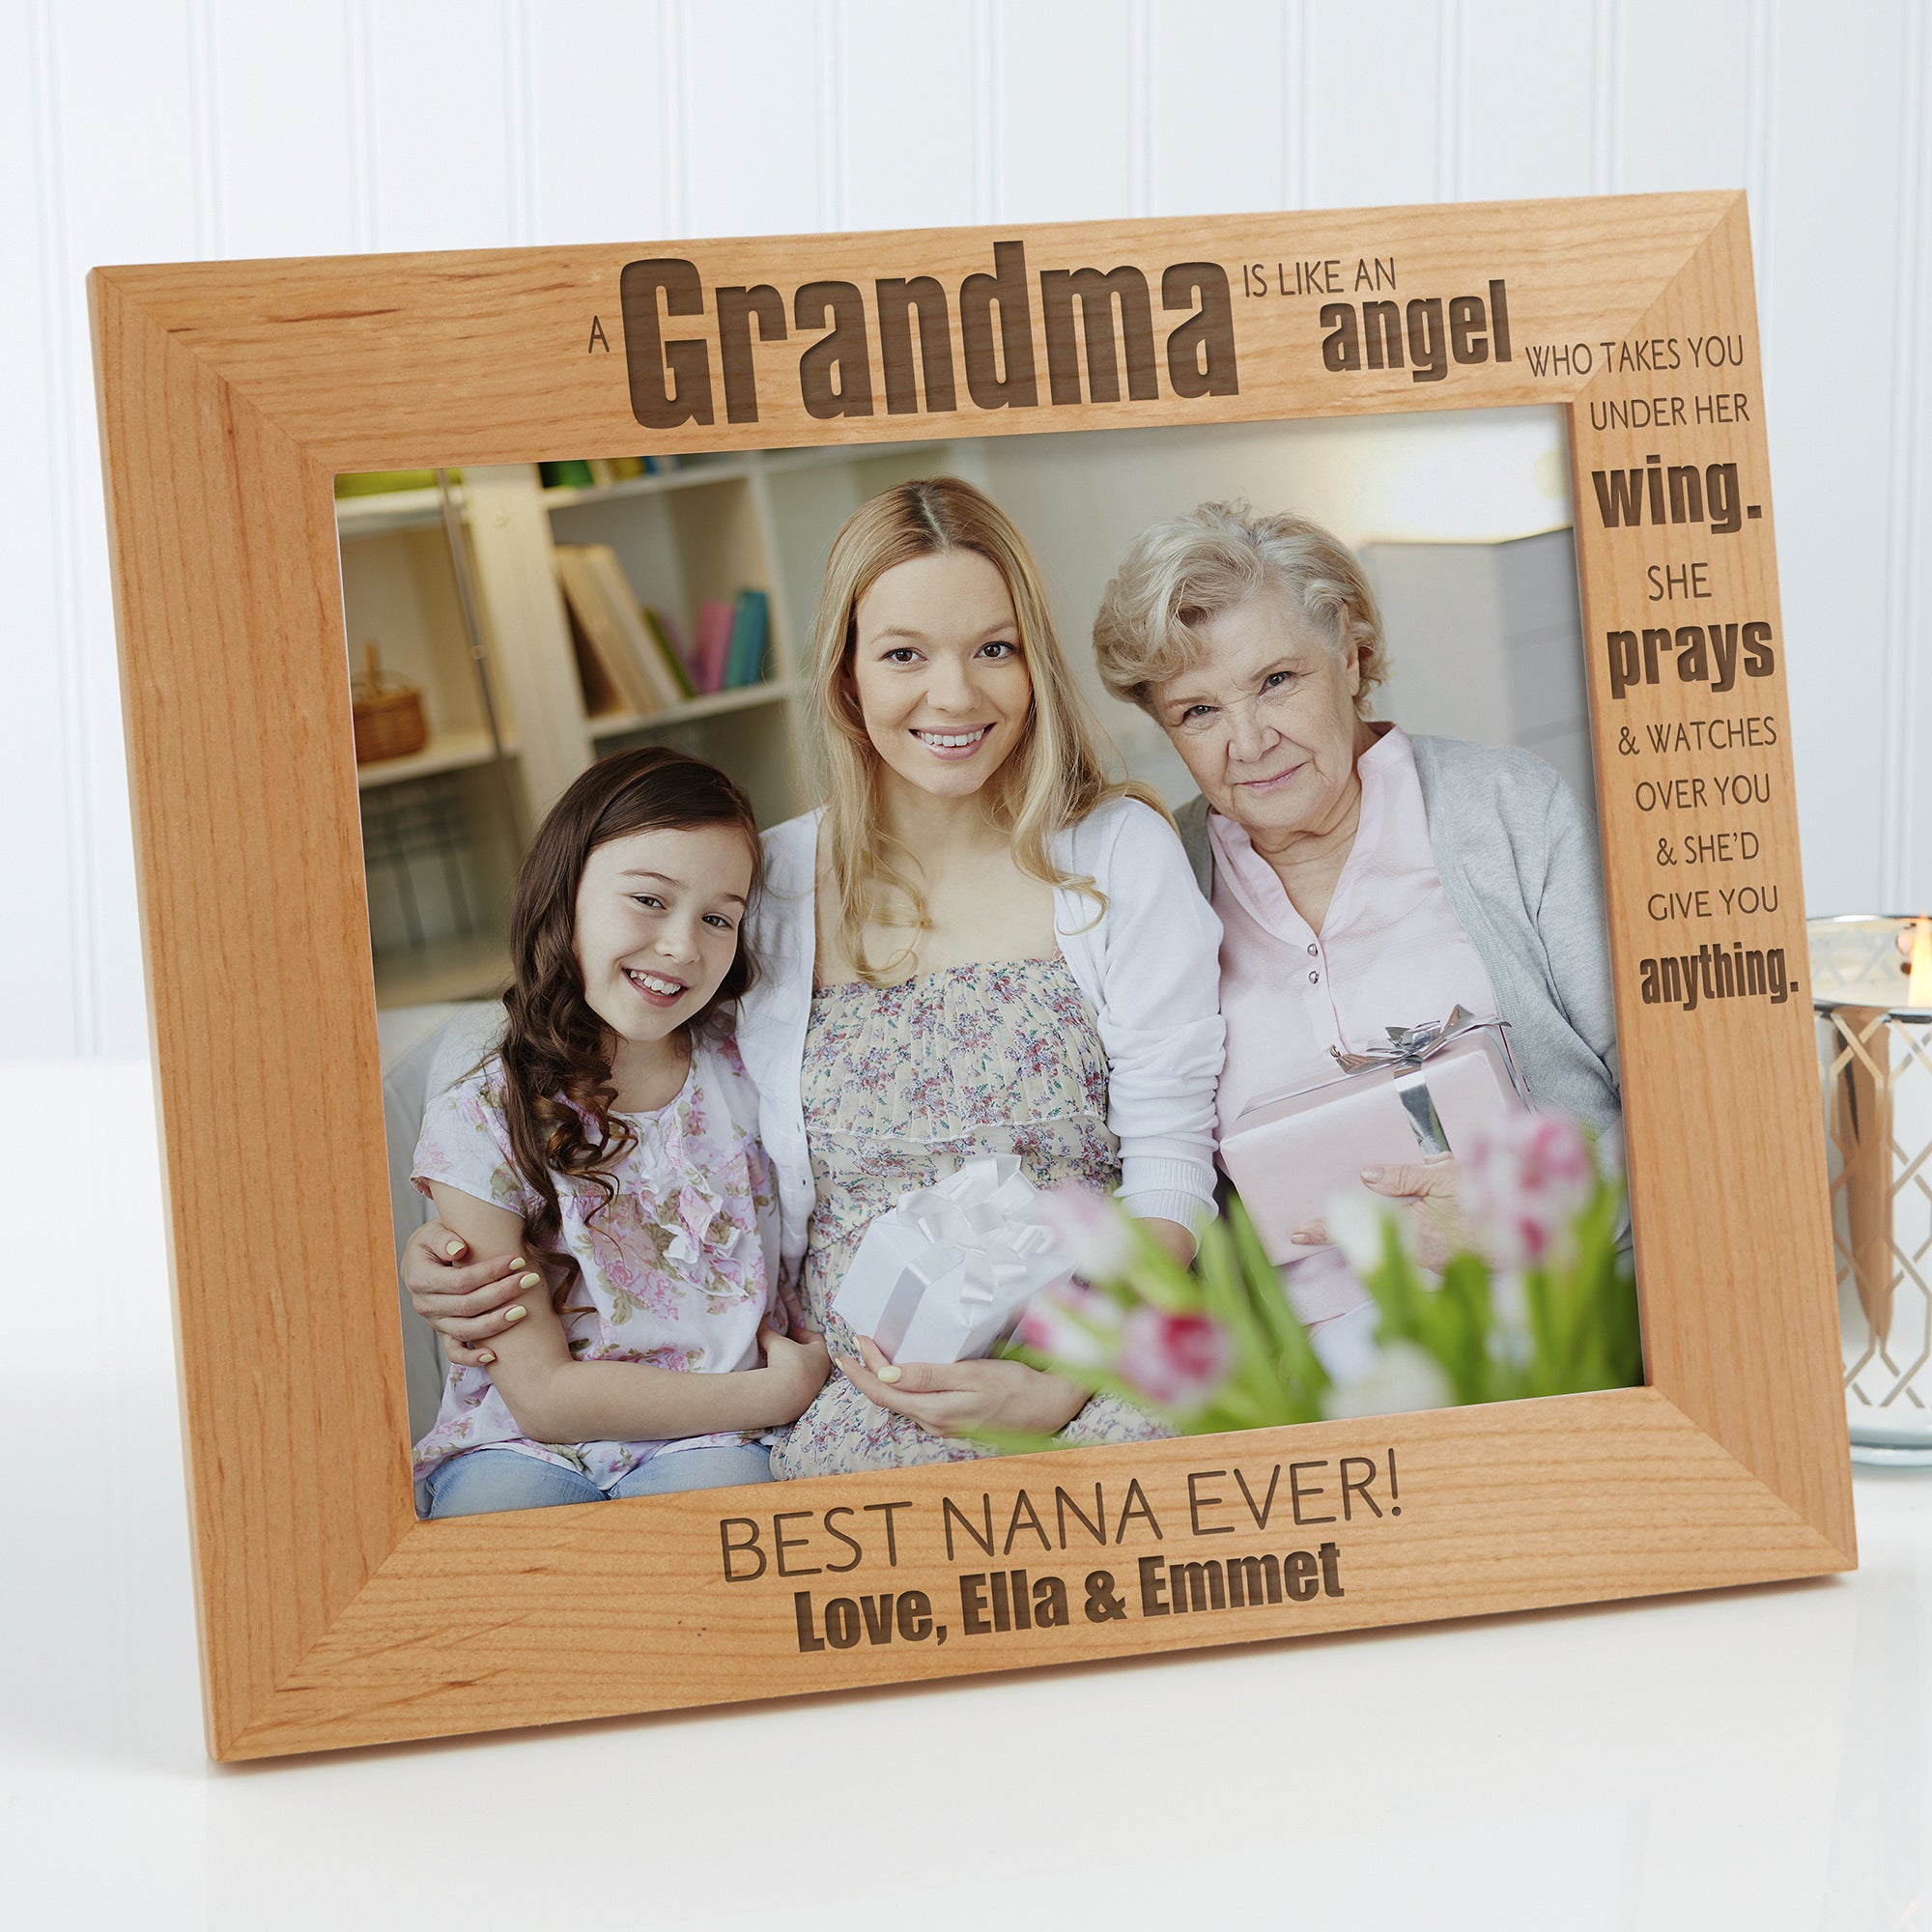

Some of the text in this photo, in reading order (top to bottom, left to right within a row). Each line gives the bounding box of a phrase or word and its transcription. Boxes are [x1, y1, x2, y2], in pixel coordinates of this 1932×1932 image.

[587, 240, 1397, 430] A Grandma IS LIKE AN
[1319, 278, 1513, 384] angel
[1524, 334, 1744, 378] WHO TAKES YOU
[1589, 392, 1750, 432] UNDER HER
[1590, 453, 1763, 535] wing.
[1646, 561, 1713, 602] SHE
[1605, 621, 1776, 700] prays
[1618, 715, 1777, 756] & WATCHES
[1634, 773, 1771, 812] OVER YOU
[1656, 831, 1760, 867] & SHE'D
[1647, 884, 1778, 922] GIVE YOU
[1639, 941, 1800, 1012] anything.
[719, 1447, 1402, 1584] BEST NANA EVER!
[793, 1541, 1346, 1654] Love, Ella & Emmet
